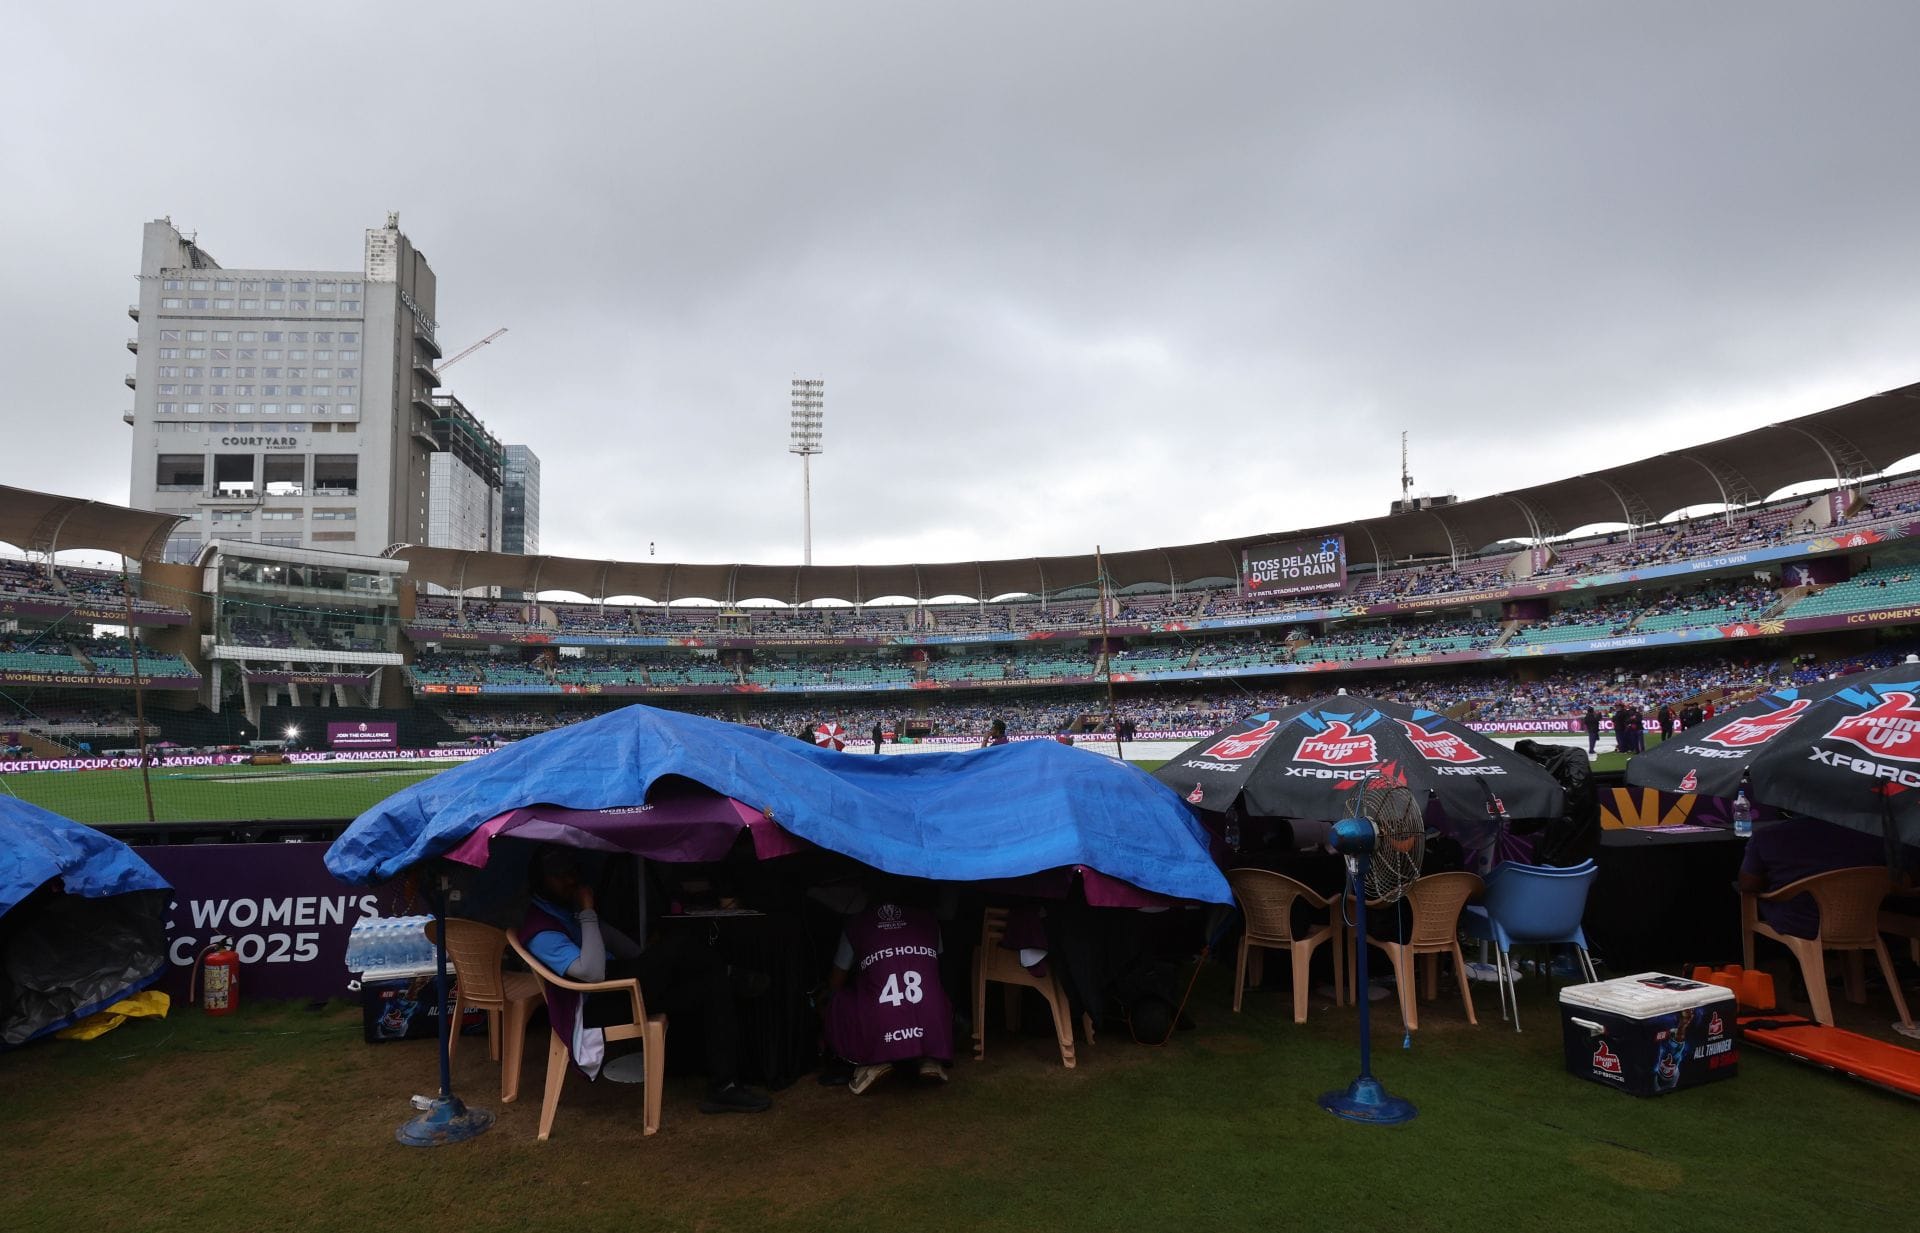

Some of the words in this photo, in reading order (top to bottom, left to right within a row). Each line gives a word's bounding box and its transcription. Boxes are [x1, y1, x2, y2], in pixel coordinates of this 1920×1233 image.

[222, 437, 297, 446] COURTYARD
[1252, 559, 1280, 572] TOSS
[1283, 552, 1335, 569] DELAYED
[1692, 559, 1711, 570] WILL
[1713, 557, 1727, 567] TO
[1728, 554, 1747, 565] WIN
[1252, 571, 1278, 583] DUE
[1281, 567, 1300, 578] TO
[1303, 563, 1336, 577] RAIN
[1258, 589, 1272, 597] PATIL
[1273, 586, 1300, 595] STADIUM,
[1316, 582, 1341, 590] MUMBAI
[1397, 601, 1409, 609] ICC
[1410, 599, 1440, 608] WOMEN'S
[1441, 594, 1469, 605] CRICKET
[1469, 592, 1494, 601] WORLD
[1494, 590, 1509, 598] CUP
[74, 609, 101, 618] FINAL
[1223, 615, 1297, 626] CRICKETWORLDCUP.COM
[1847, 613, 1866, 624] ICC
[1868, 608, 1920, 622] WOMEN'S
[1590, 640, 1612, 649] NAVI
[1612, 637, 1646, 647] MUMBAI
[5, 674, 53, 682] WOMEN'S
[55, 675, 94, 684] CRICKET
[97, 677, 130, 685] WORLD
[1305, 741, 1370, 753] Thums
[1414, 737, 1459, 751] Thums
[1676, 745, 1752, 758] XFORCE
[1181, 760, 1242, 772] XFORCE
[1431, 766, 1508, 776] XFORCE
[190, 894, 380, 929] WOMEN'S
[895, 946, 938, 959] HOLDER
[878, 970, 924, 1006] 48
[884, 1027, 924, 1042] #CWG
[1694, 1046, 1704, 1060] ALL
[1706, 1038, 1732, 1056] THUNDER
